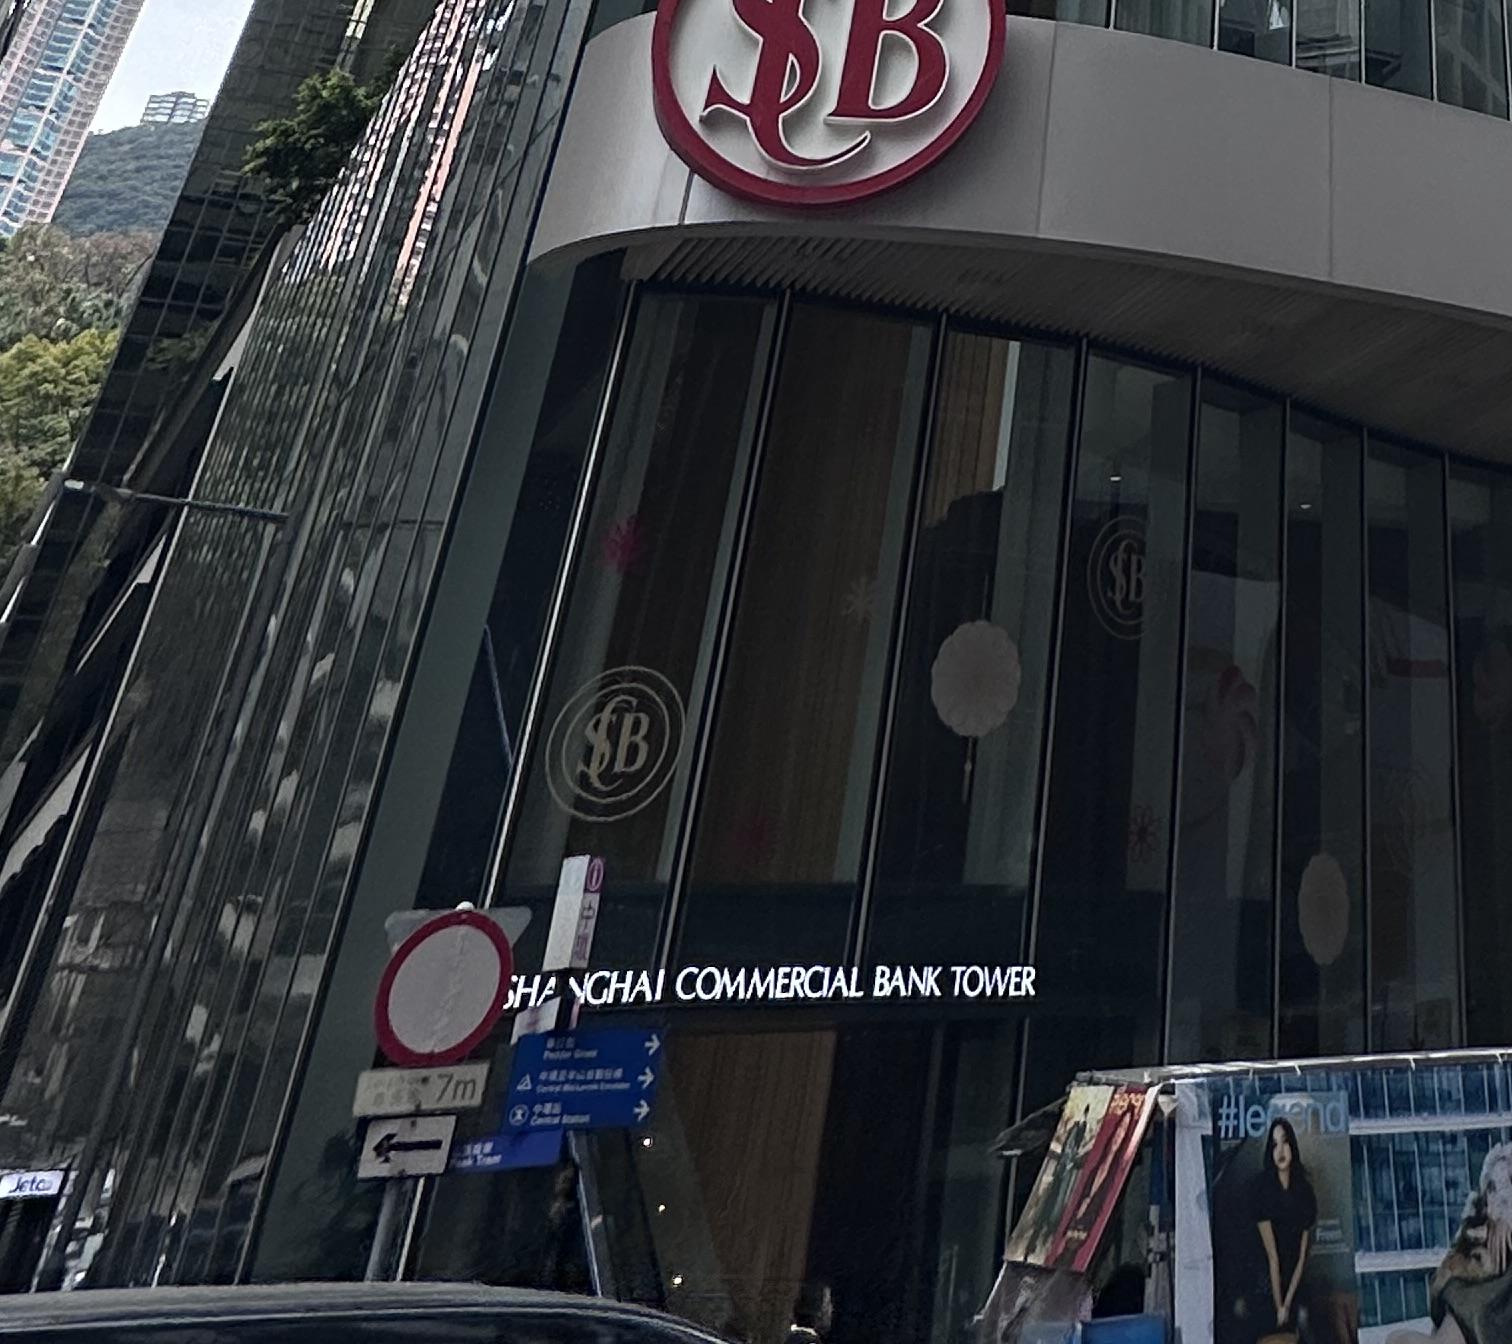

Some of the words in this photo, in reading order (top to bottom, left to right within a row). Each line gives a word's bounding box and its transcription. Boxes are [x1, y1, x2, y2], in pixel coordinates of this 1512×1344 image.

[675, 965, 864, 1000] COMMERCIAL
[873, 964, 942, 998] BANK
[950, 964, 1036, 998] TOWER
[437, 1073, 476, 1103] 7m
